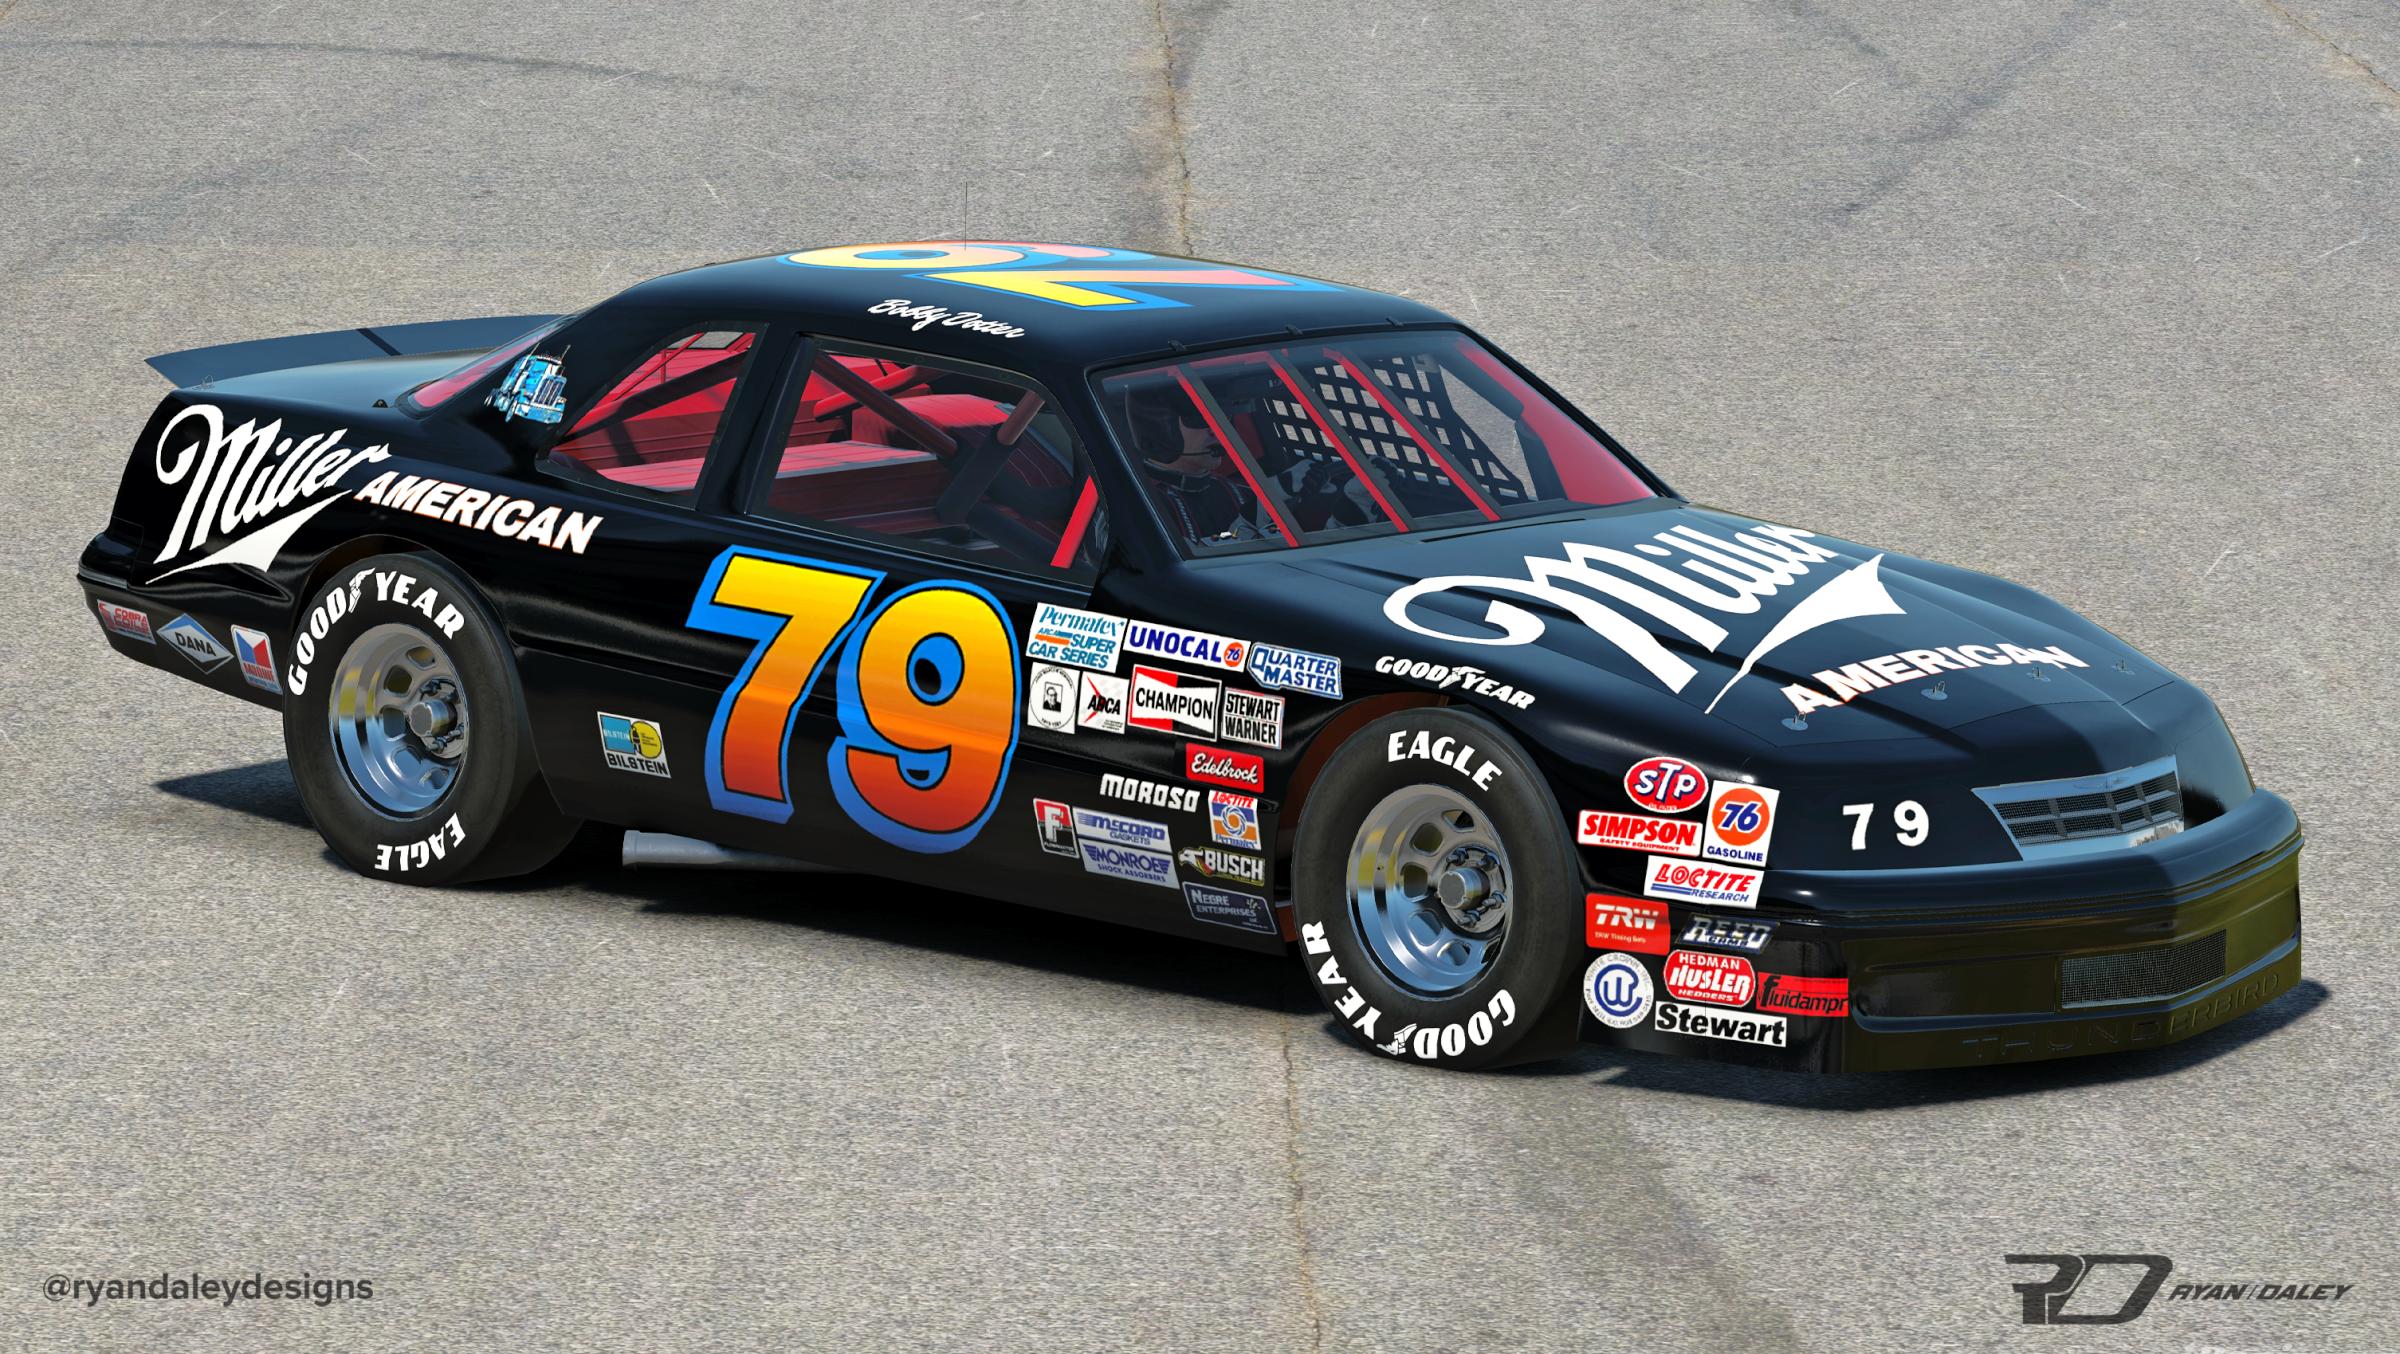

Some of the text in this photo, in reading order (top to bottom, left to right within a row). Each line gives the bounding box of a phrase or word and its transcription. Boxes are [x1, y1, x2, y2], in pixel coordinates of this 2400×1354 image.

[867, 299, 1025, 339] Bobby Dotter
[153, 403, 392, 565] Miller
[353, 470, 604, 555] AMERICAN
[1039, 606, 1125, 637] Permatex
[1382, 524, 1839, 694] Miller
[174, 631, 217, 657] DANA
[1028, 641, 1109, 669] CAR SERIES
[1070, 633, 1117, 654] SUPER
[1128, 625, 1222, 663] UNOCAL
[1250, 647, 1339, 675] QUARTER
[1261, 665, 1338, 694] MASTER
[1375, 655, 1536, 710] GOODYEAR
[1780, 643, 2091, 714] AMERICAN
[685, 544, 1022, 854] 79
[1135, 687, 1213, 721] CHAMPION
[1225, 692, 1281, 722] STEWART
[1224, 715, 1278, 745] WARNER
[606, 752, 669, 776] BILSTEIN
[1191, 752, 1259, 784] Edelbrock
[1387, 730, 1502, 792] EAGLE
[1100, 773, 1201, 813] MOROSO
[1634, 761, 1697, 801] STP
[1212, 791, 1256, 808] LOCTITE
[1584, 814, 1698, 847] SIMPSON
[1722, 803, 1762, 832] 76
[374, 812, 466, 872] EAGLE
[1109, 831, 1151, 846] GASKETS
[1600, 838, 1680, 852] SAFETY EQUIPMENT
[1707, 845, 1764, 863] GASOLINE
[1093, 846, 1163, 875] MONROE
[1097, 863, 1122, 875] SHOCK
[1204, 849, 1263, 881] BUSCH
[1654, 863, 1756, 892] LOCTITE
[1191, 888, 1230, 907] NEGRE
[1691, 889, 1749, 903] RESEARCH
[1595, 903, 1659, 930] TRW
[1683, 917, 1771, 949] REED
[1679, 954, 1740, 970] HEDMAN
[1669, 965, 1751, 1001] HUSLER
[1760, 975, 1848, 1014] fluidampr
[1656, 1004, 1785, 1045] Stewart
